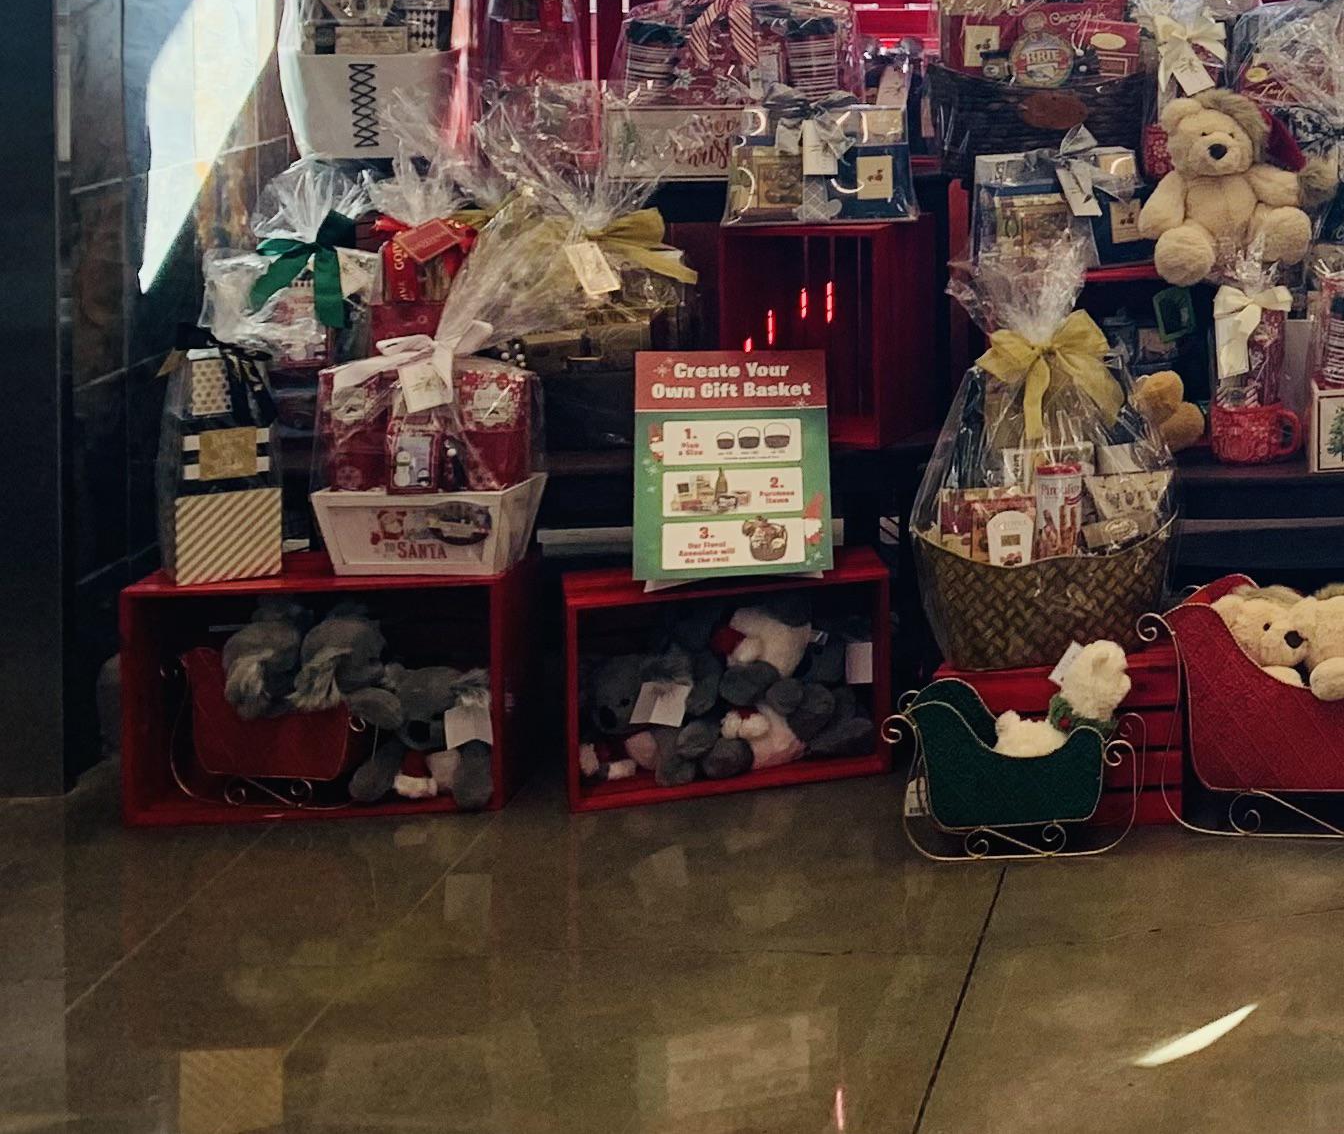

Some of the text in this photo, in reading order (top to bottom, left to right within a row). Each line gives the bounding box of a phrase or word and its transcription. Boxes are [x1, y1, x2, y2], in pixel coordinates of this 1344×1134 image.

[1026, 50, 1062, 64] BRIE
[673, 362, 790, 378] Create Your
[651, 381, 811, 399] Own Gift Basket
[684, 428, 698, 439] 1.
[769, 477, 784, 488] 2.
[699, 527, 716, 539] 3.
[397, 541, 447, 560] SANTA
